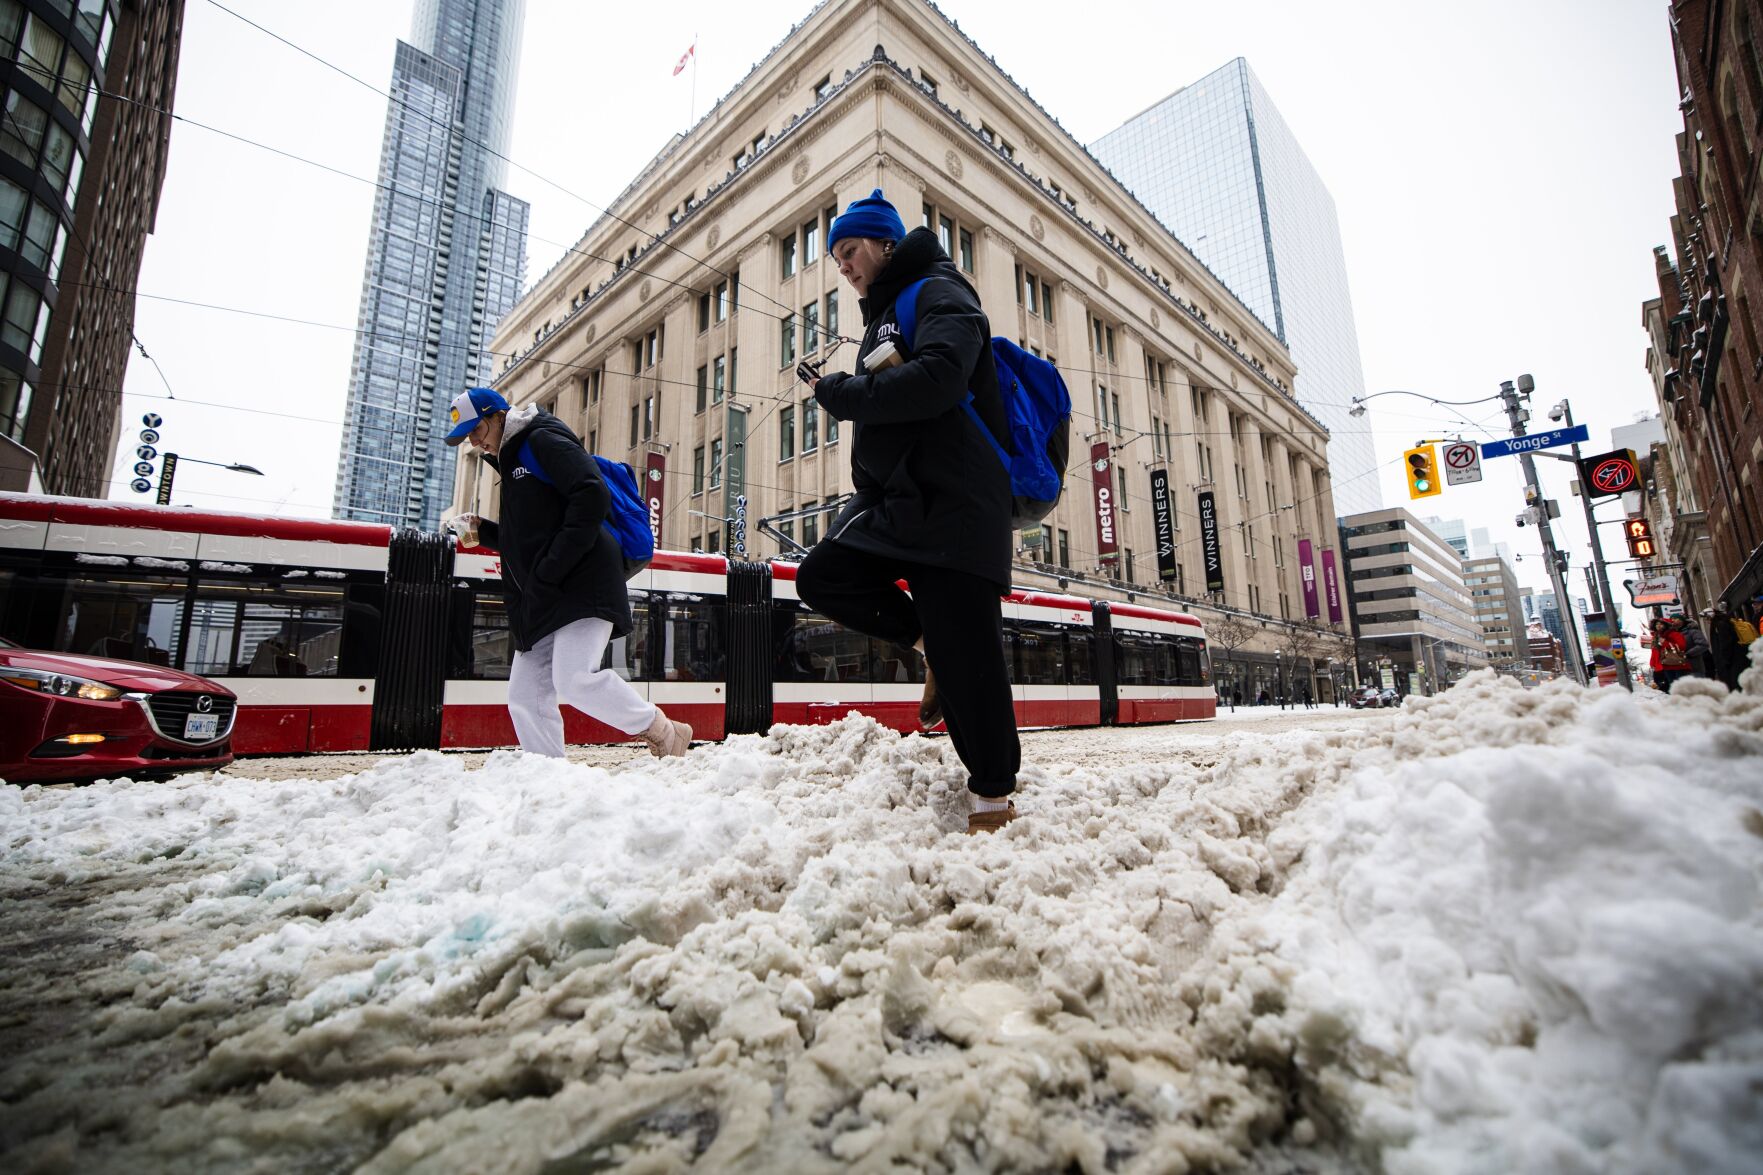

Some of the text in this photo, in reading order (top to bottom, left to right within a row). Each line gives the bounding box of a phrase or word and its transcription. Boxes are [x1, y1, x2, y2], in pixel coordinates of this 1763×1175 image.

[131, 412, 162, 494] Yonge
[1504, 431, 1561, 451] Yonge St
[159, 457, 175, 505] OWNTOWN
[735, 495, 747, 552] Yonge
[1098, 487, 1113, 543] metro
[1155, 477, 1171, 557] WINNERS
[1202, 499, 1218, 571] WINNERS
